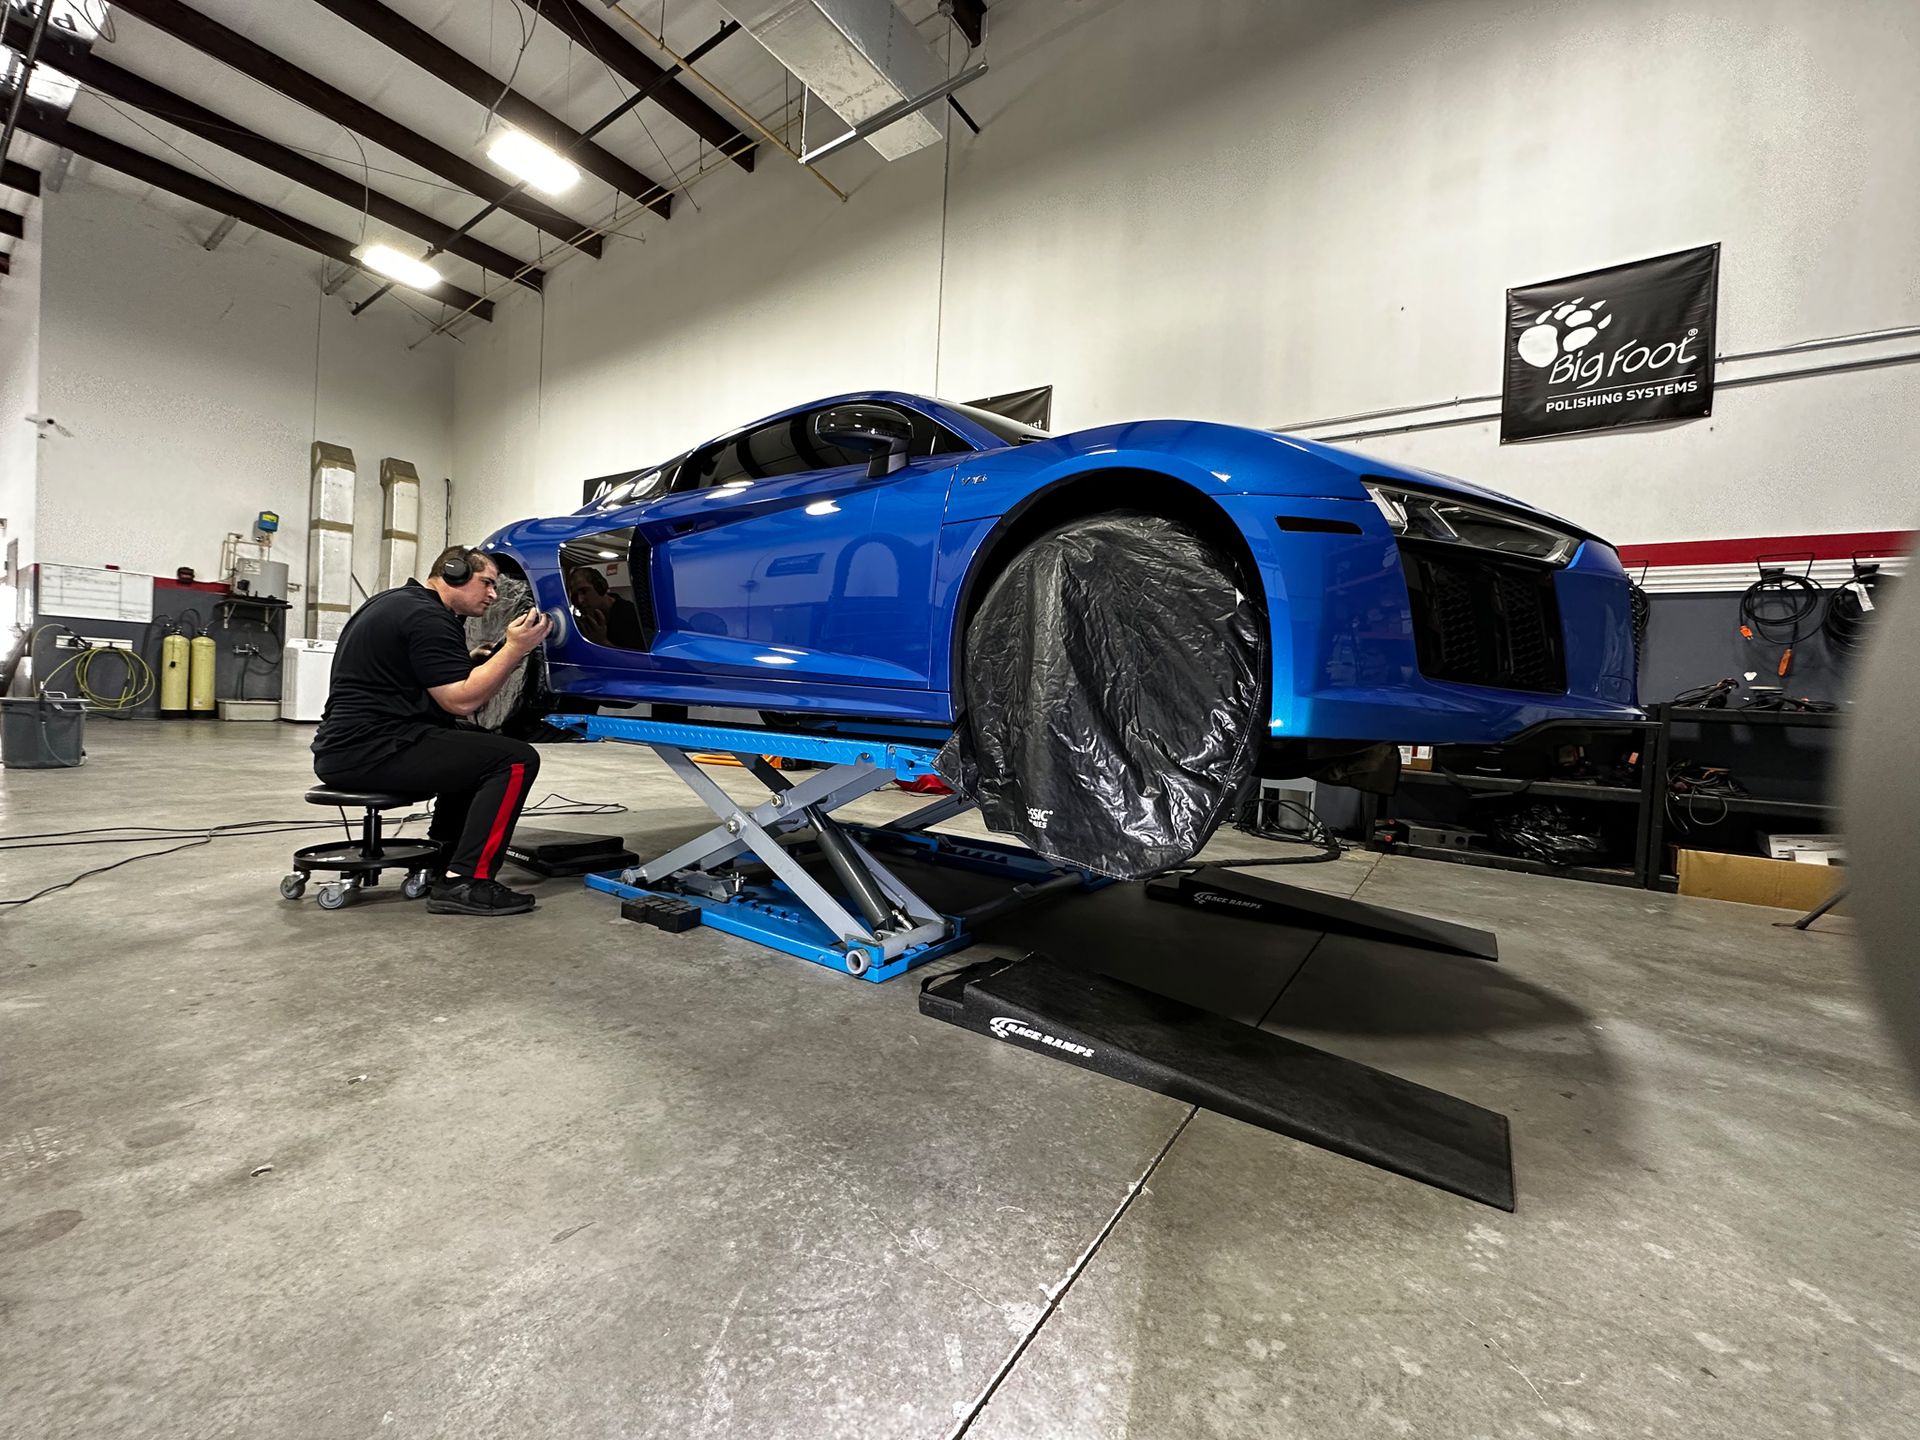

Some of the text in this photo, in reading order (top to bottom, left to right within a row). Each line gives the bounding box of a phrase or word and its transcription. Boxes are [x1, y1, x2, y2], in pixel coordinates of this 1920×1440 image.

[1549, 350, 1604, 389] Big
[1546, 380, 1698, 413] POLISHING SYSTEMS
[1005, 1023, 1095, 1058] RACE RAMPS
